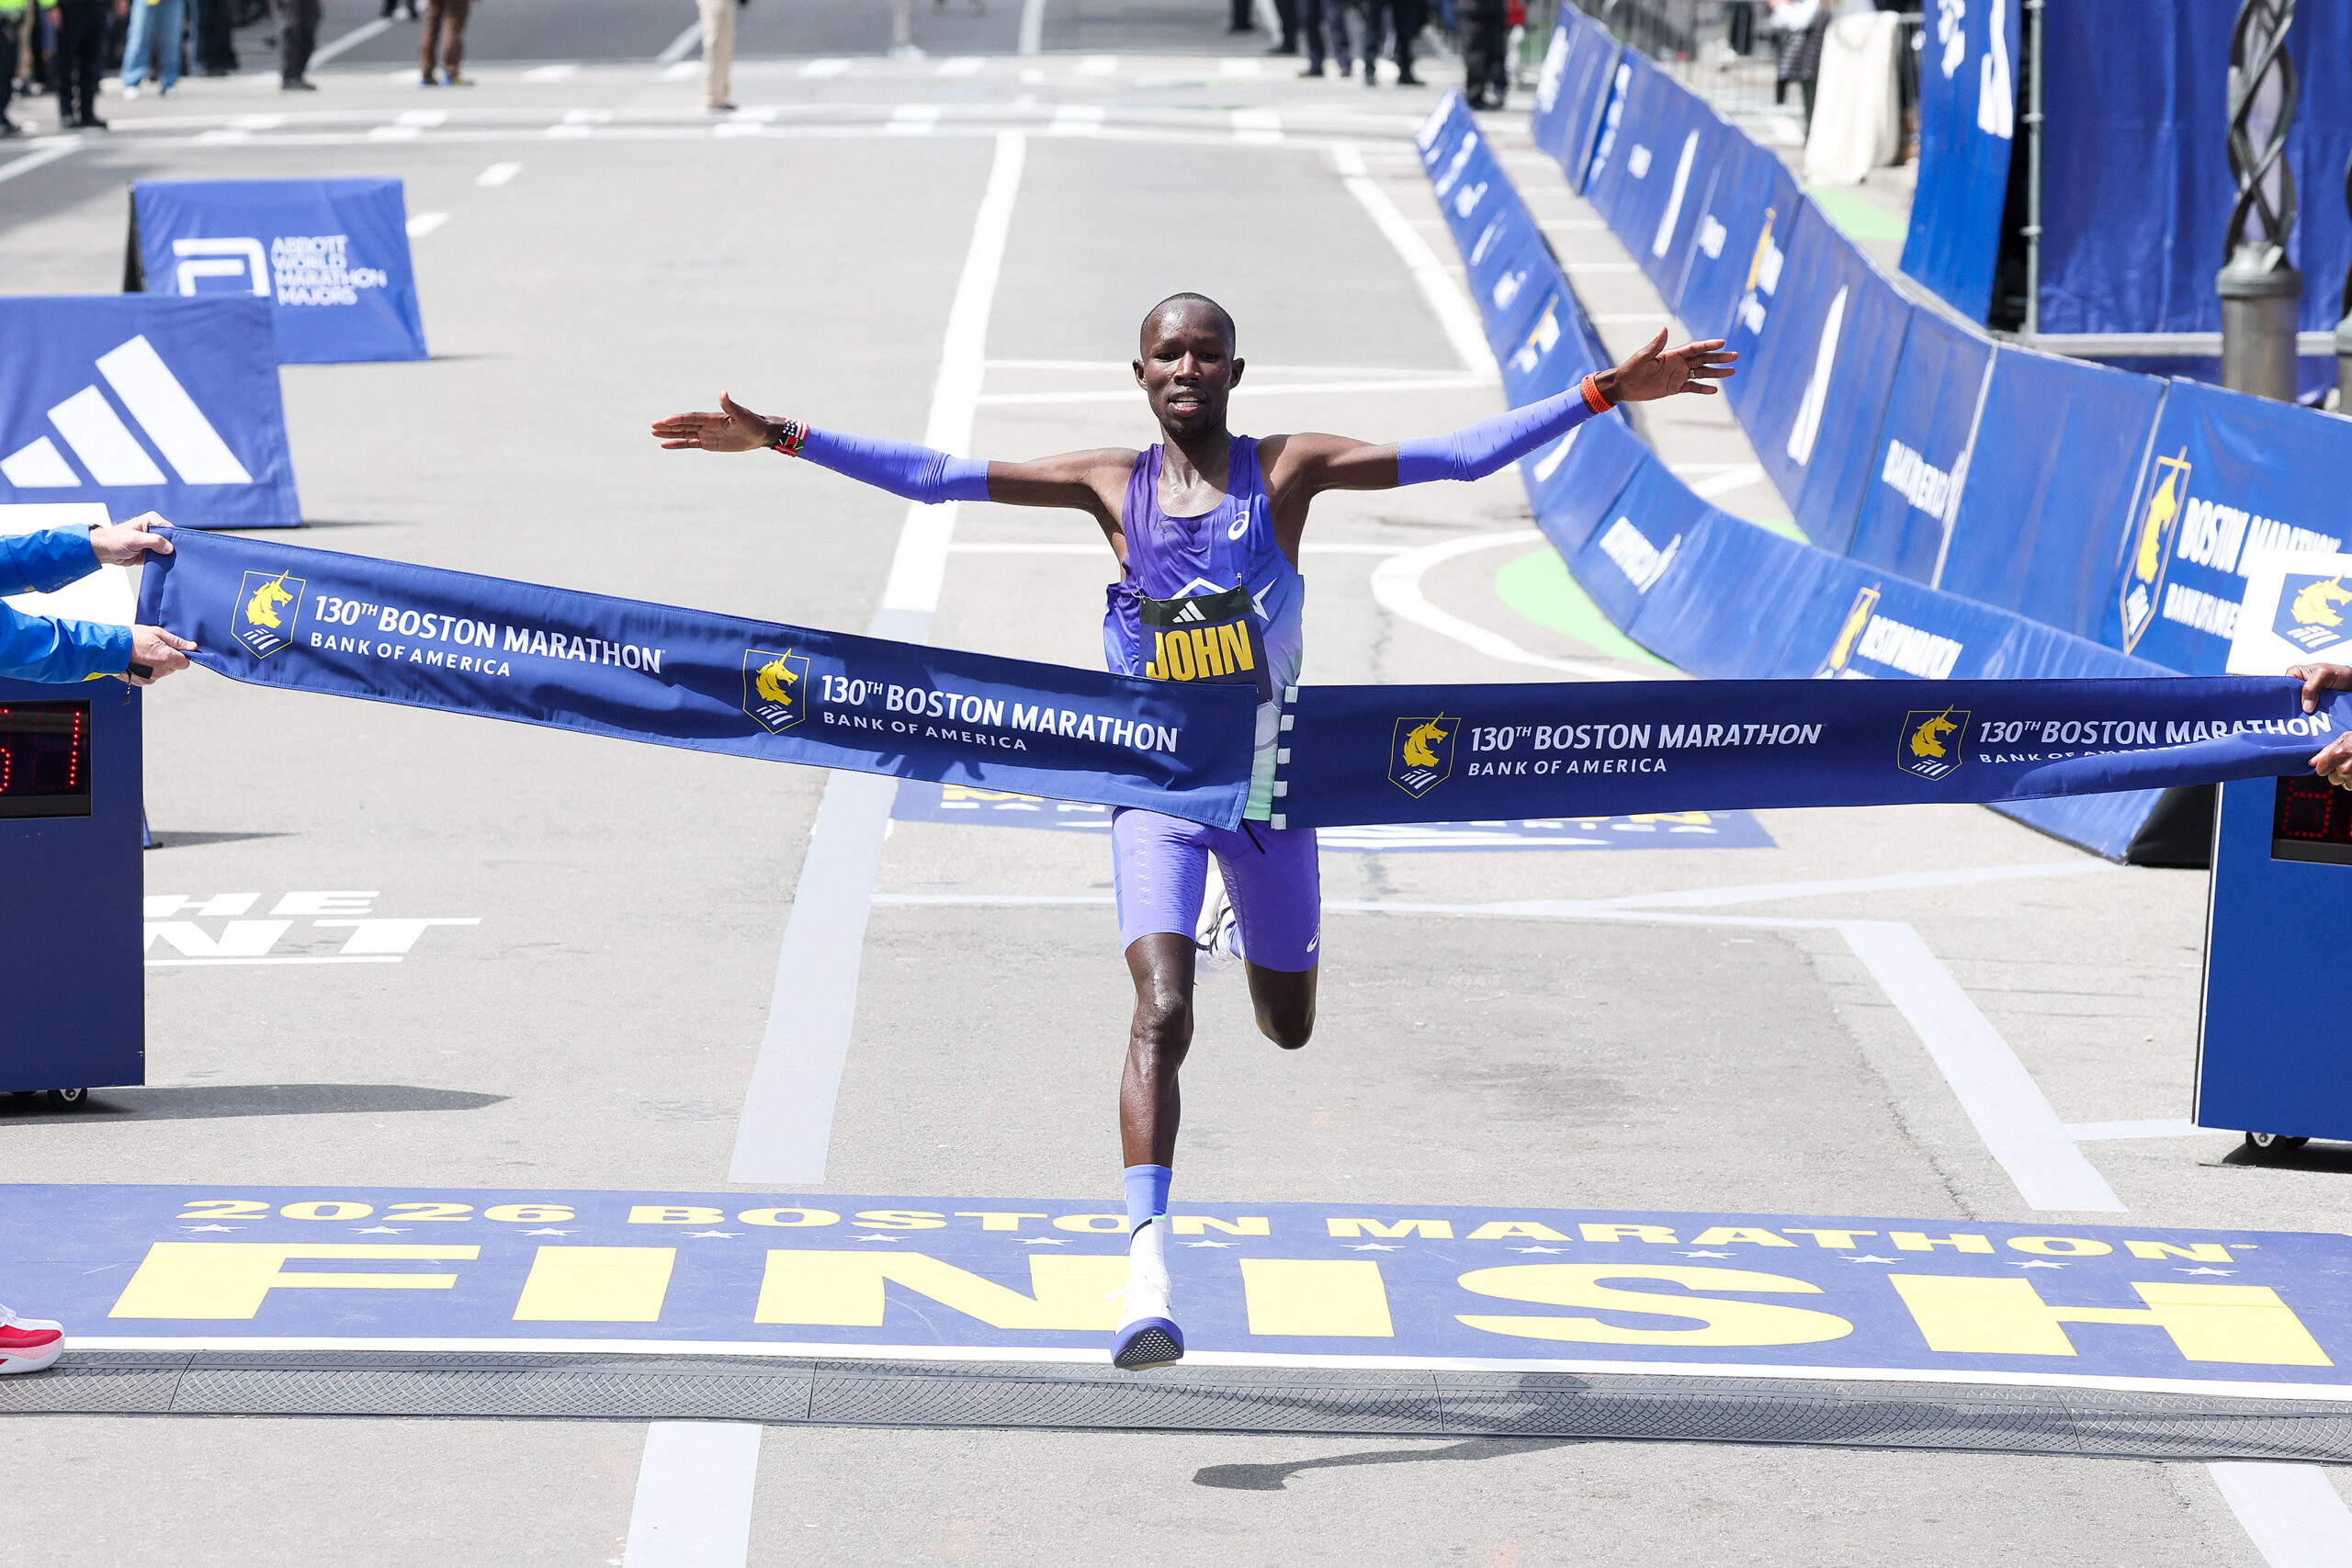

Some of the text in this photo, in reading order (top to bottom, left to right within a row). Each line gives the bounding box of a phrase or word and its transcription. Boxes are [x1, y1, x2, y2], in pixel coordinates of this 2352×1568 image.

[311, 631, 511, 677] BANK OF AMERICA
[377, 605, 496, 649] BOSTON
[503, 626, 662, 675] MARATHON
[1146, 620, 1255, 682] JOHN
[823, 711, 1027, 751] BANK OF AMERICA
[886, 684, 1005, 727] BOSTON
[1012, 703, 1178, 753] MARATHON
[1533, 724, 1651, 750] BOSTON
[1657, 724, 1823, 750] MARATHON
[2041, 720, 2157, 745] BOSTON
[2165, 712, 2333, 744] MARATHON
[1468, 758, 1667, 776] BANK OF AMERICA
[1979, 753, 2041, 763] BANK
[175, 1200, 2235, 1263] 2026 BOSTON MARATHON
[107, 1241, 2335, 1367] FINISH
